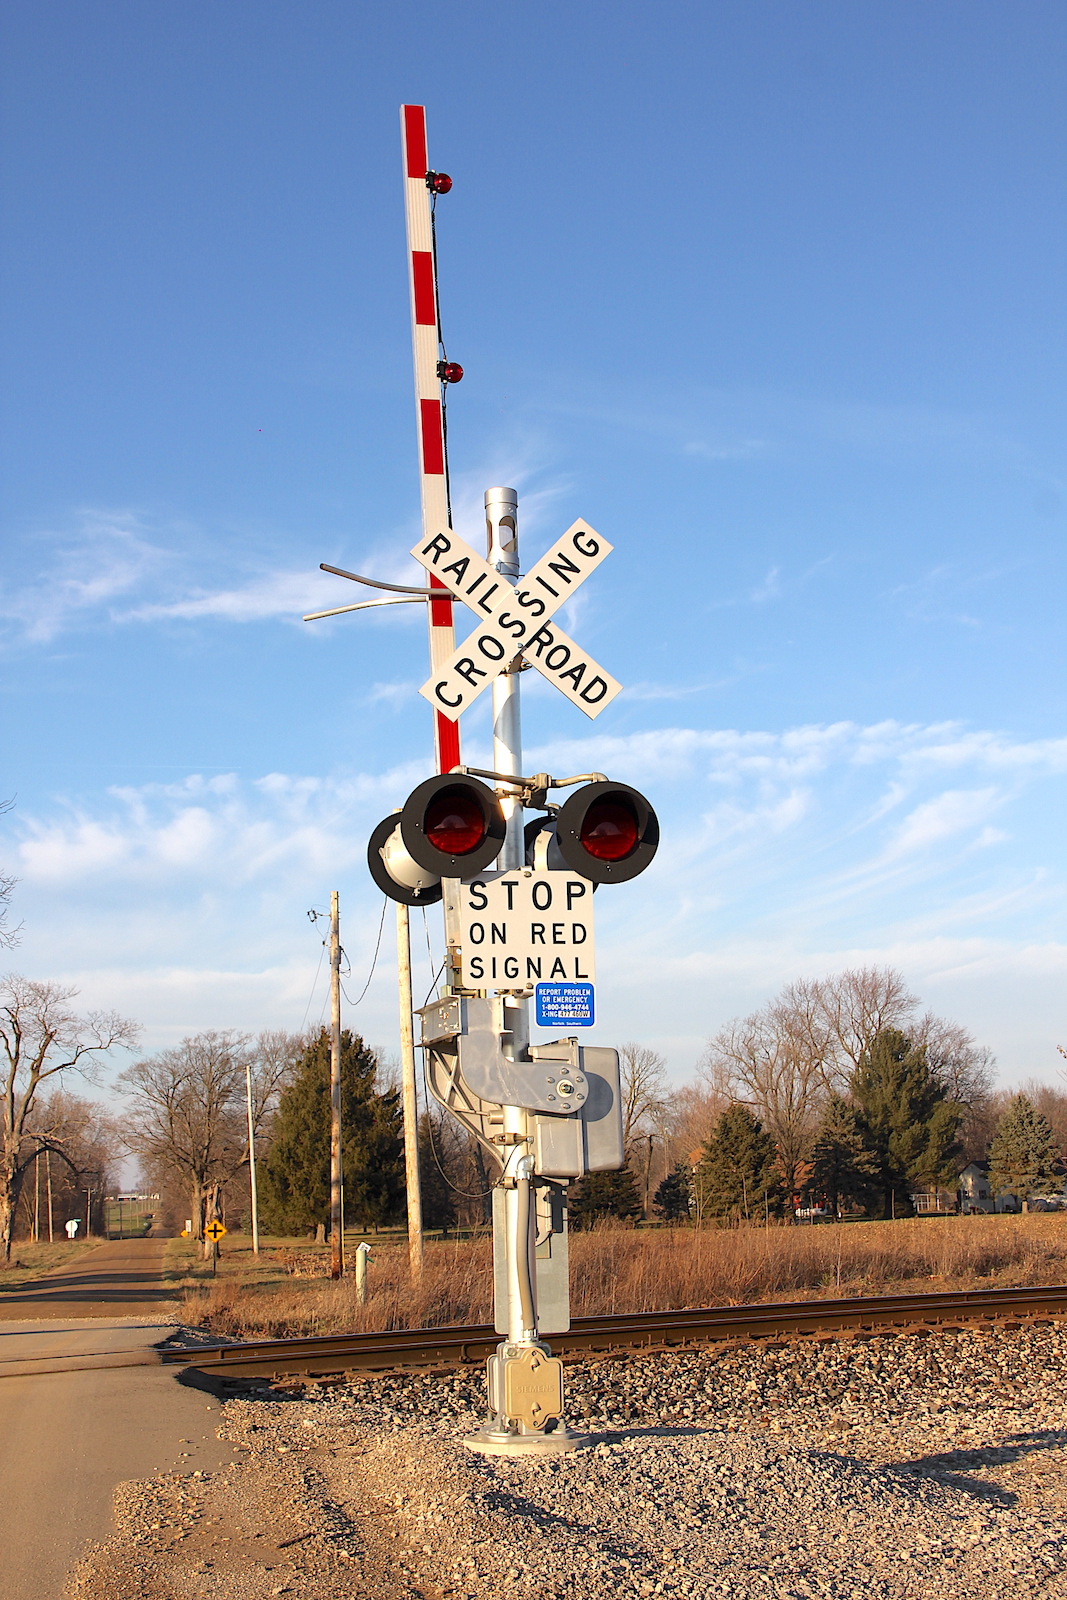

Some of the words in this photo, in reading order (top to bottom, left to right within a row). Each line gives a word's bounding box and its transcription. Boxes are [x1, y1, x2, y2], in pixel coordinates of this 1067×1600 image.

[422, 533, 499, 614] RAIL
[435, 531, 600, 708] CROSSING
[525, 625, 608, 704] ROAD
[468, 880, 586, 911] STOP
[469, 922, 507, 945] ON
[531, 922, 587, 945] RED
[469, 956, 589, 979] SIGNAL
[516, 1384, 555, 1394] SIEMENS
